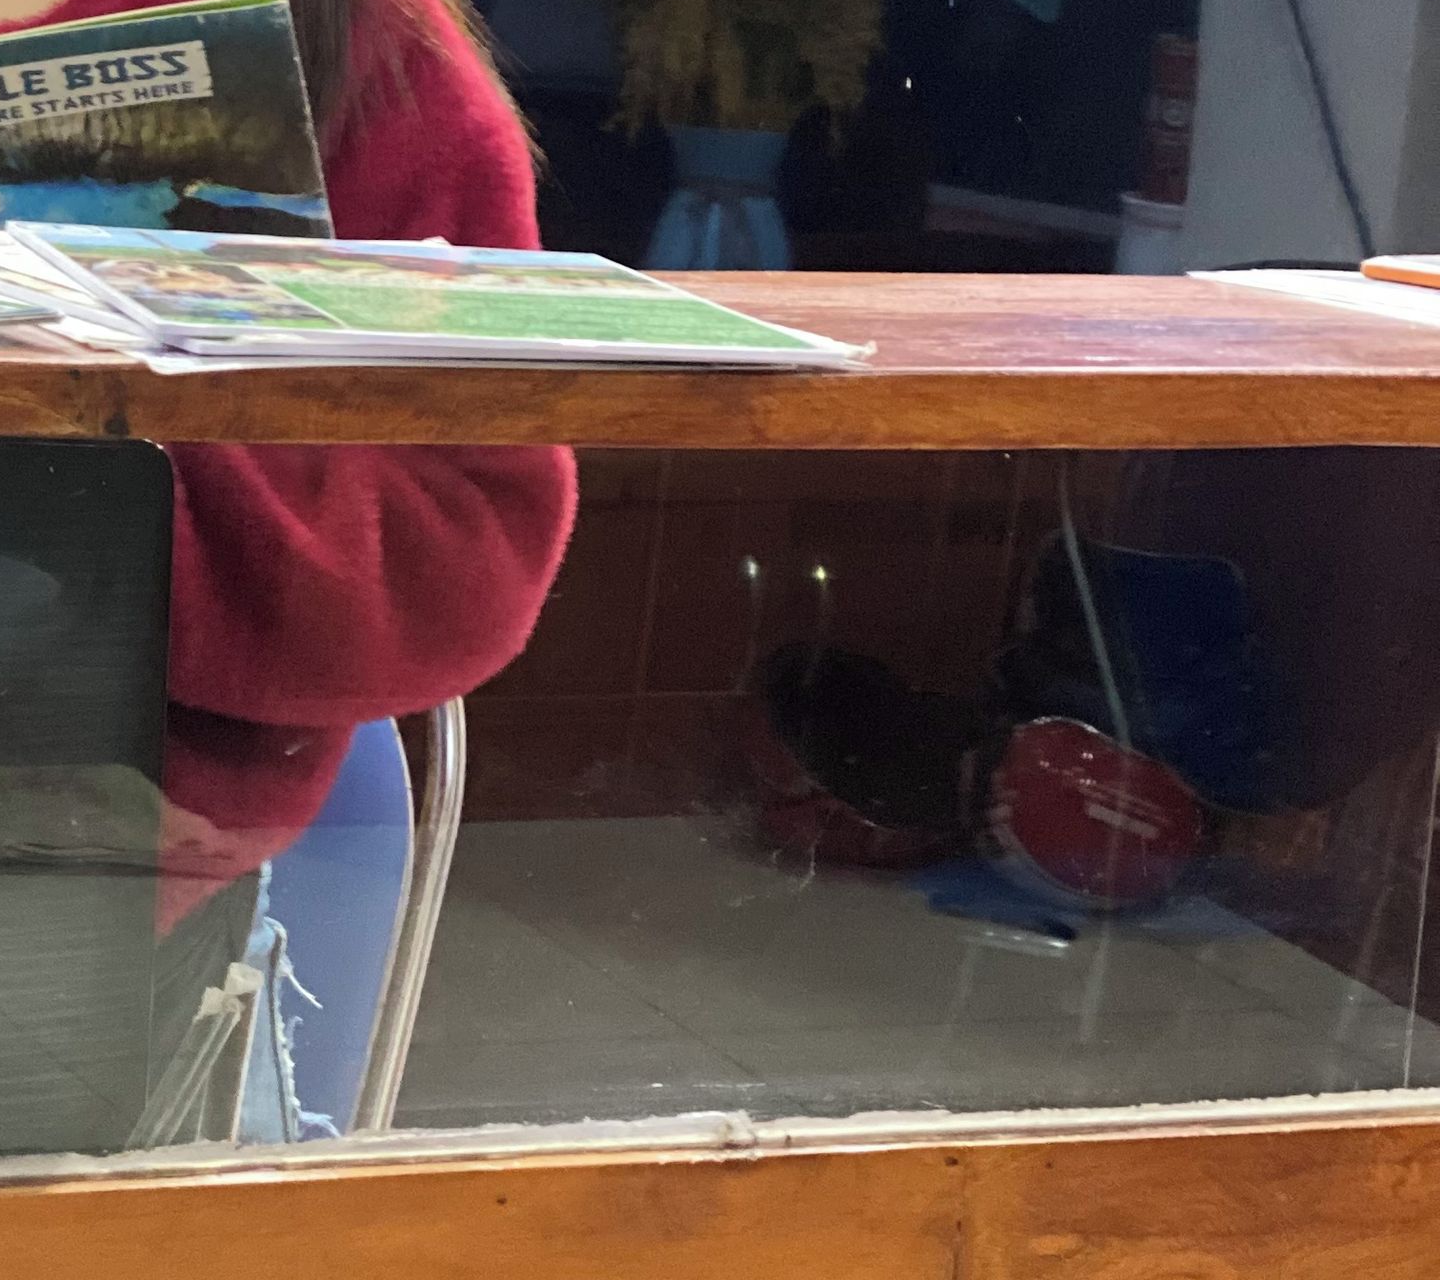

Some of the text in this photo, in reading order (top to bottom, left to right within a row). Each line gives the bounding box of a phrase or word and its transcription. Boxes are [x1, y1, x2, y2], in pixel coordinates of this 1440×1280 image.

[62, 50, 190, 90] BOSS
[31, 89, 125, 116] STARTS
[133, 79, 195, 101] HERE
